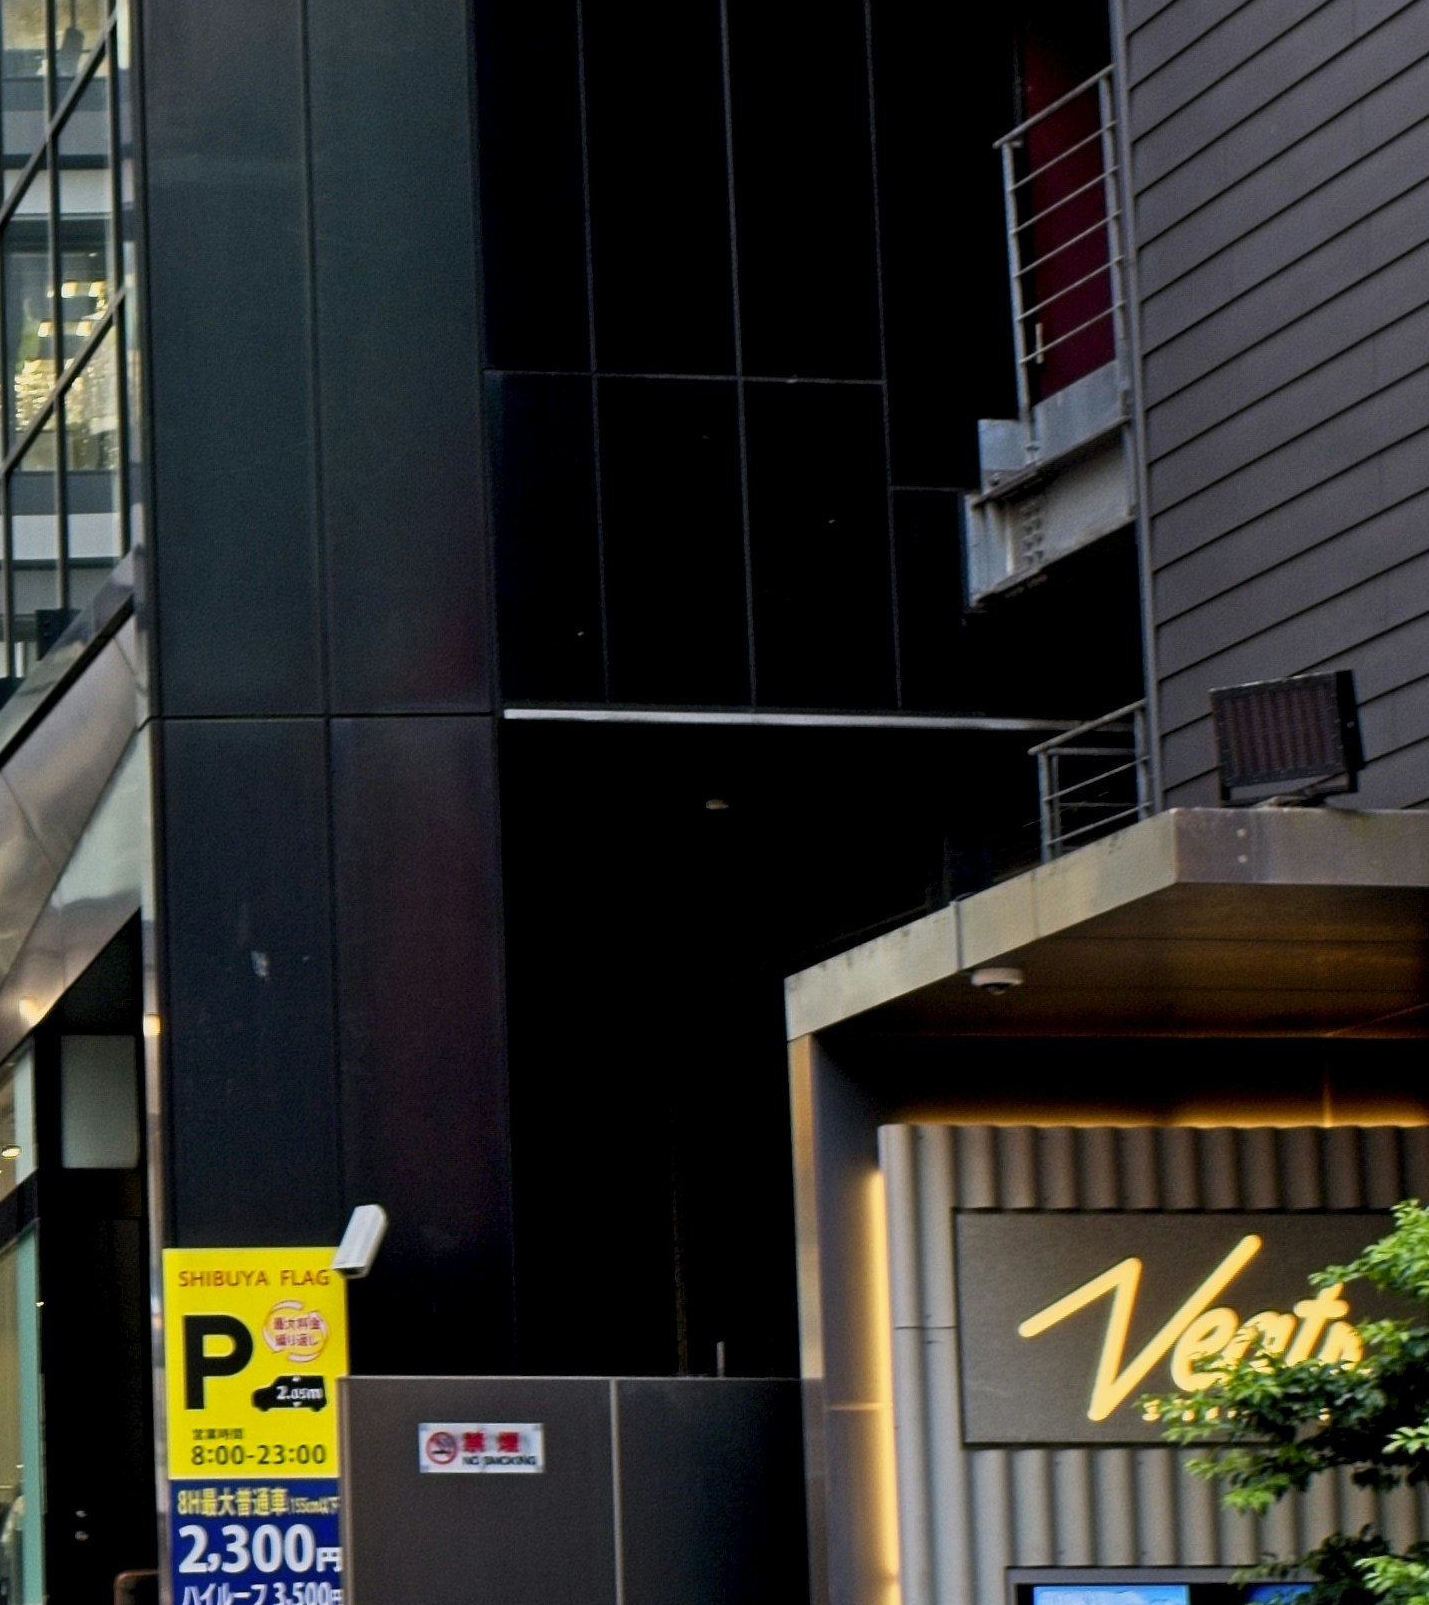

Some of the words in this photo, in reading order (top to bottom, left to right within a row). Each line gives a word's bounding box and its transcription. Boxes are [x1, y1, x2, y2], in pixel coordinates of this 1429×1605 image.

[178, 1270, 269, 1288] SHIBUYA
[280, 1269, 330, 1287] FLAG
[183, 1314, 254, 1411] P
[191, 1444, 326, 1466] 8:00-23:00
[177, 1487, 289, 1517] 8H最大普通車
[178, 1523, 343, 1574] 2,300円
